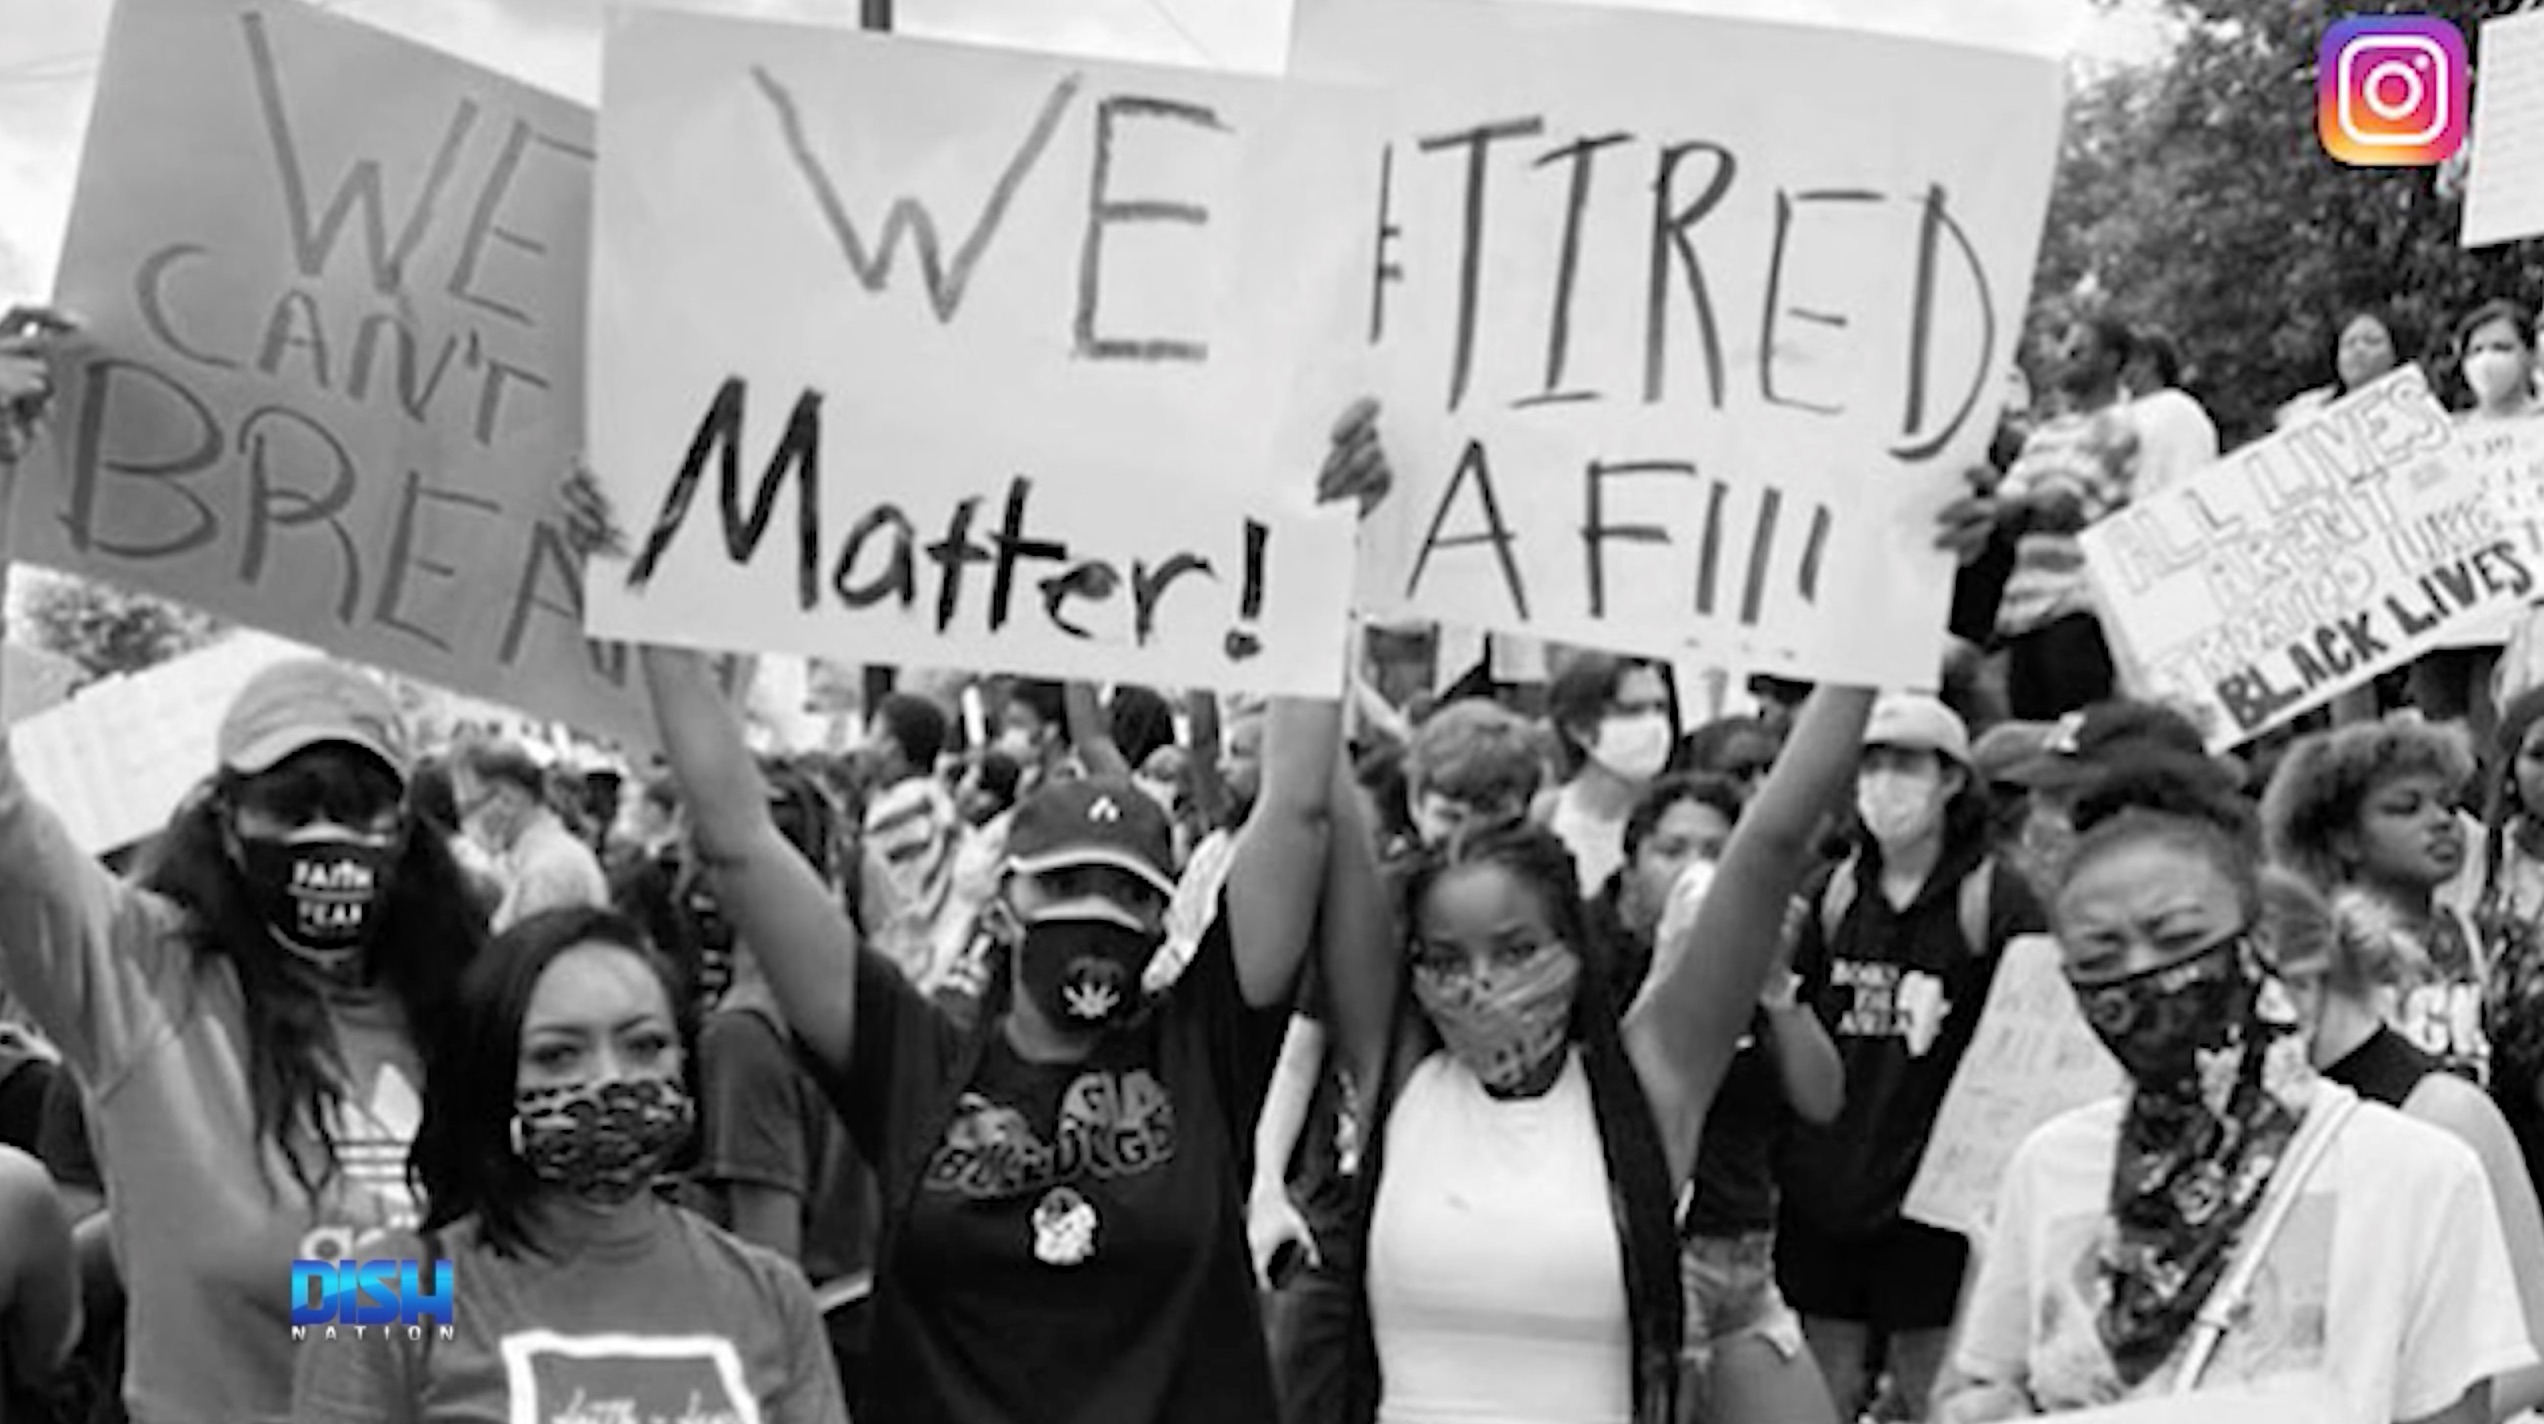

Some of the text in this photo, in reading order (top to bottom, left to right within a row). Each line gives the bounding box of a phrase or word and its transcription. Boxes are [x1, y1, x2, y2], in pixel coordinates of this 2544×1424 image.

[243, 12, 598, 327] WE
[750, 63, 1236, 363] WE
[1417, 115, 1998, 462] TIRED
[135, 242, 552, 447] CAN'T
[2104, 487, 2245, 596] ALL
[2243, 370, 2452, 515] LIVES
[58, 358, 628, 690] BREA
[625, 375, 1270, 662] Matter!
[2216, 540, 2534, 731] BLACK LIVES
